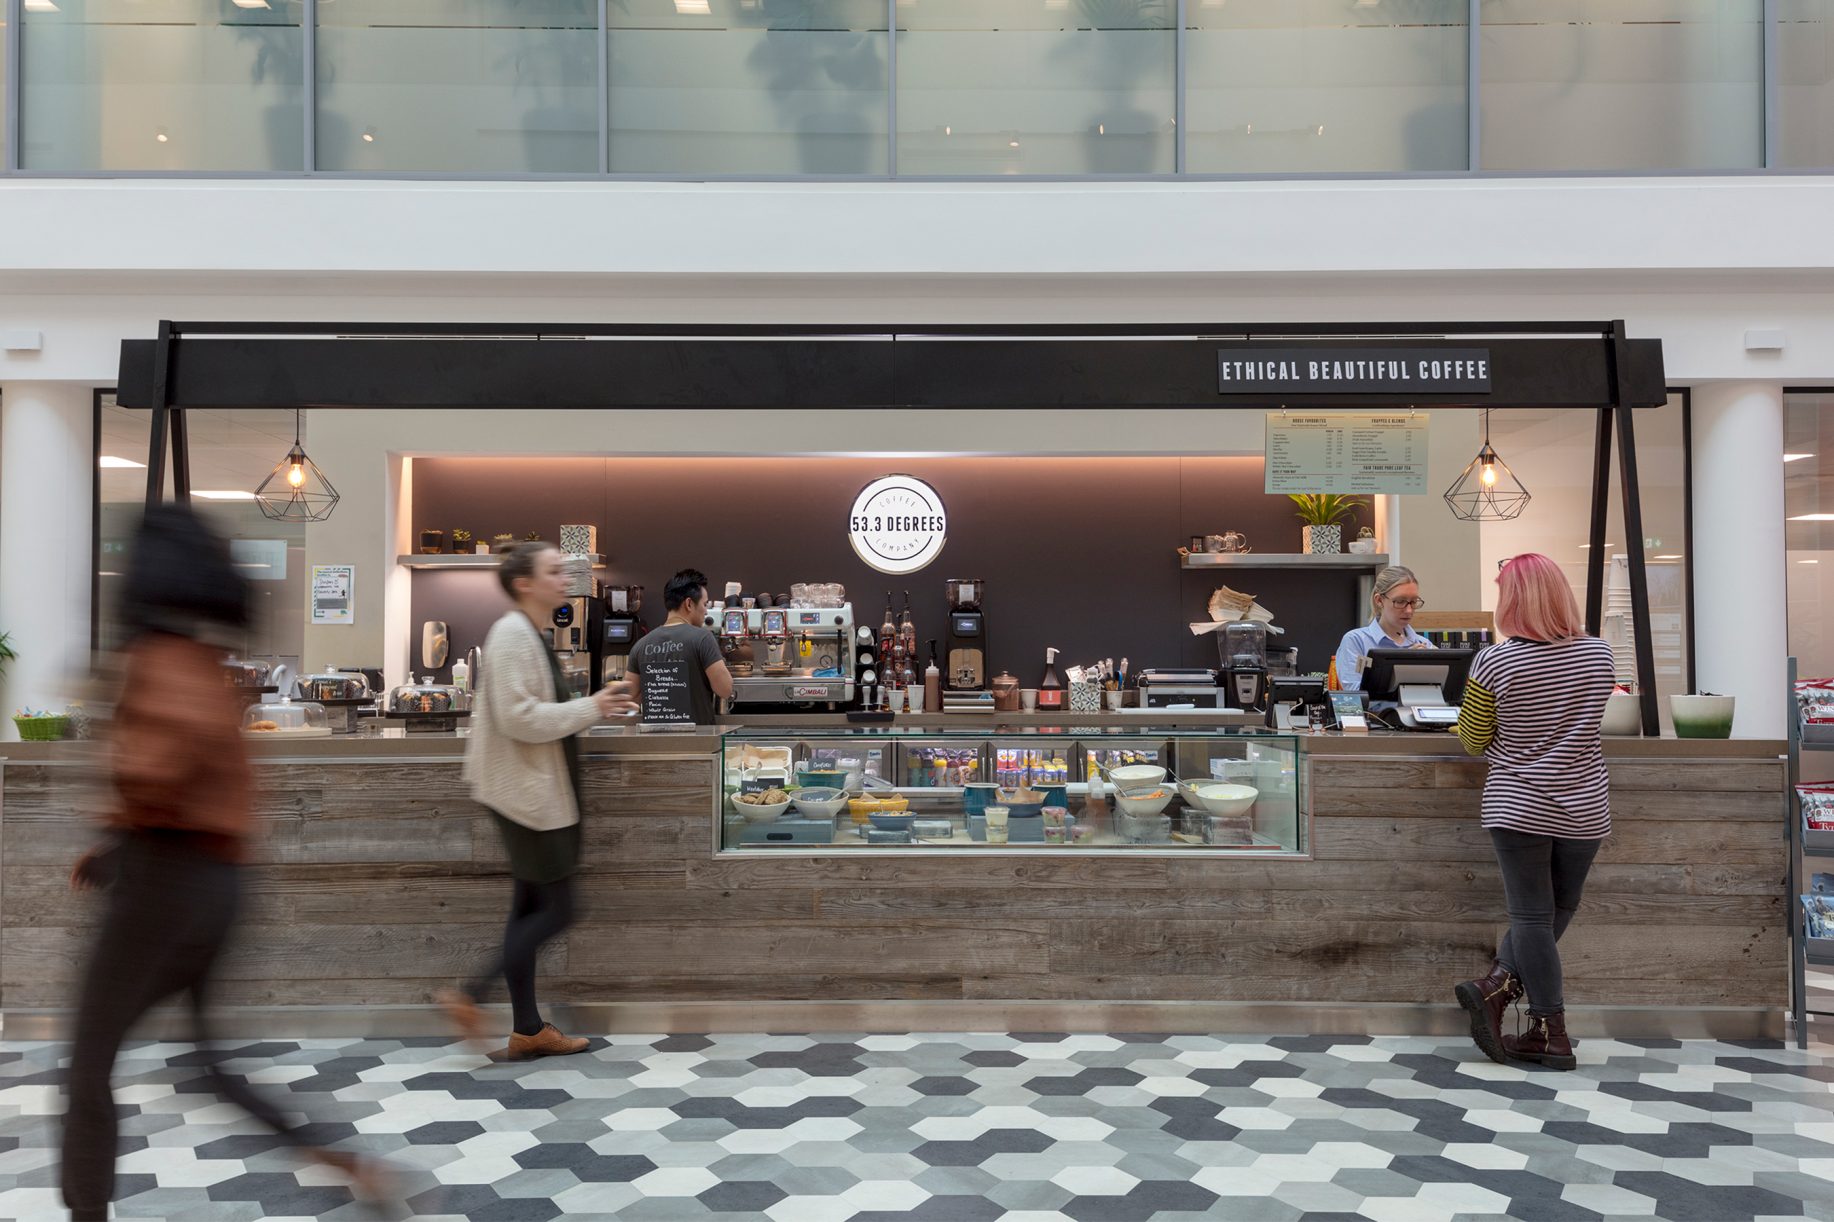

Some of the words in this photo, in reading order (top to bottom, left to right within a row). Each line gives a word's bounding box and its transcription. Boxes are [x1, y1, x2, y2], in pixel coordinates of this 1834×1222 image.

[1222, 361, 1300, 380] ETHICAL
[1309, 360, 1410, 380] BEAUTIFUL
[1419, 360, 1488, 380] COFFEE
[880, 496, 916, 508] COFFEE
[852, 516, 882, 532] 53.3
[888, 516, 943, 532] DEGREES
[875, 538, 920, 552] COMPANY
[644, 640, 684, 656] Coffee
[646, 664, 671, 674] Selection
[799, 688, 827, 696] CIMBALI
